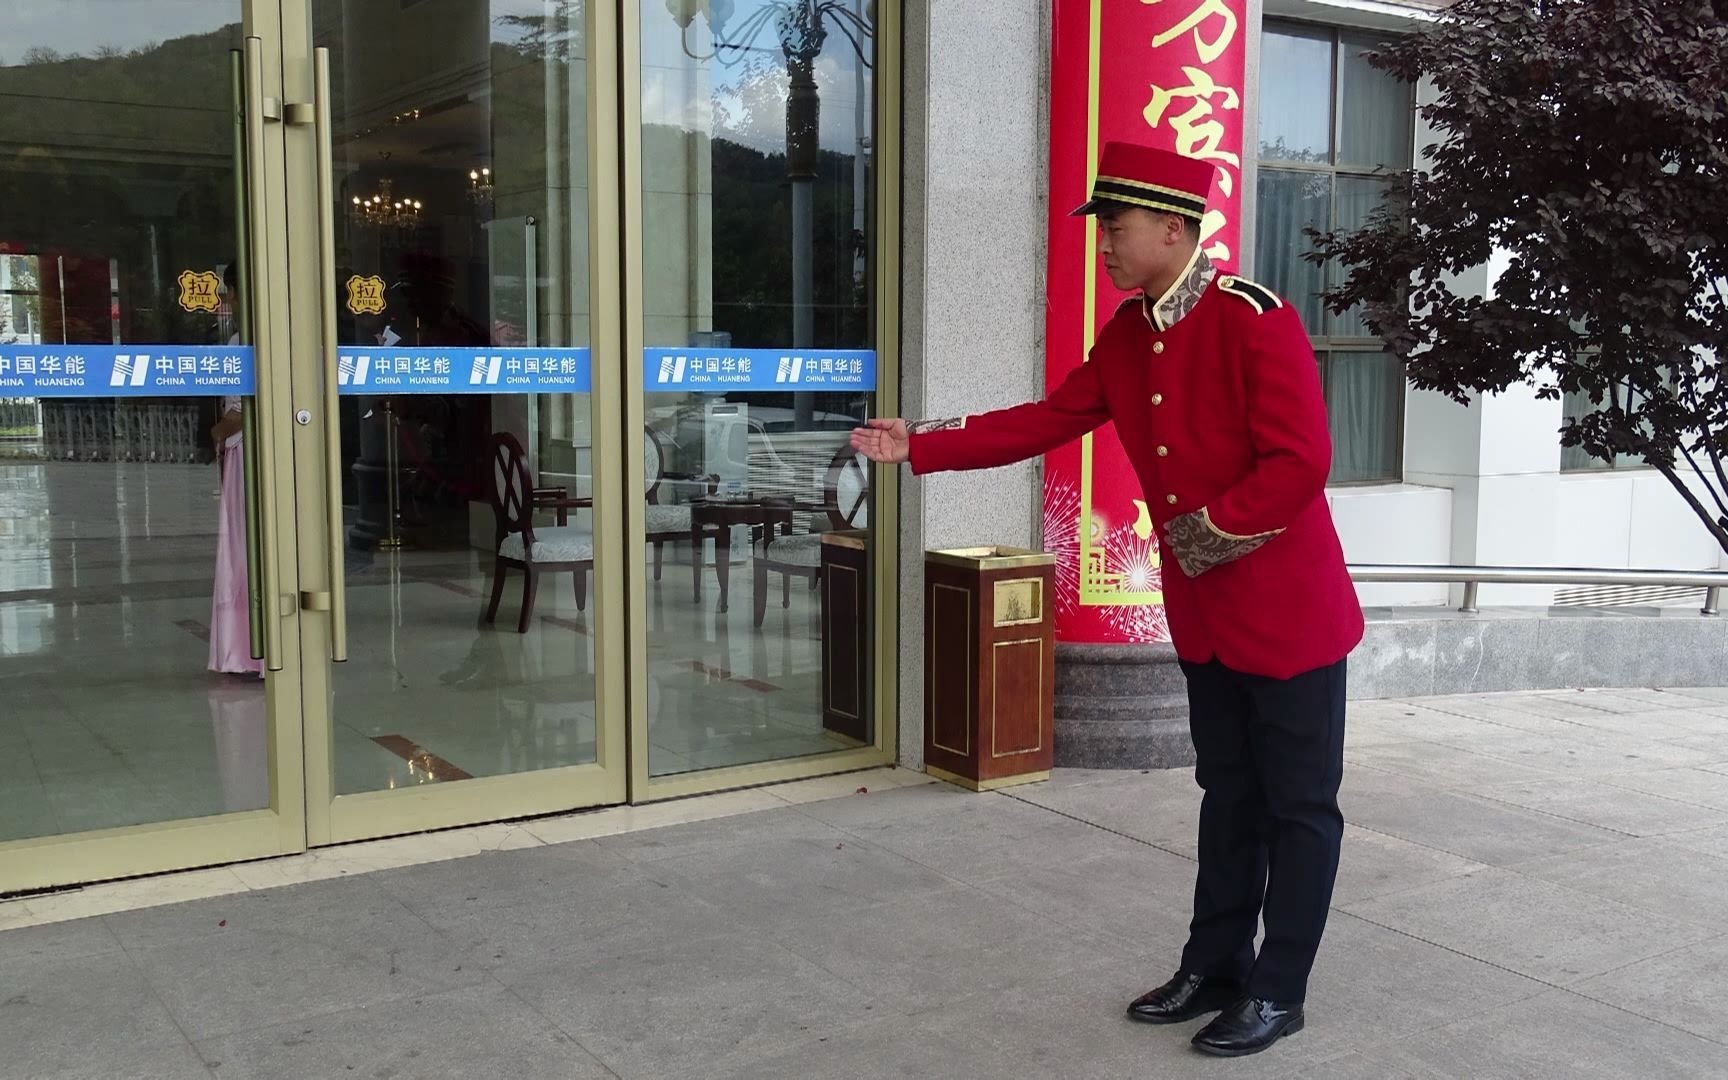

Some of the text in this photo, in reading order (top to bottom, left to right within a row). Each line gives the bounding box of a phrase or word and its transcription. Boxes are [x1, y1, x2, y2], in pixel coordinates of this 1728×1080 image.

[188, 279, 210, 296] 拉
[356, 283, 378, 299] 拉
[188, 296, 213, 304] PULL
[0, 355, 86, 375] 中国华能
[155, 355, 242, 374] 中国华能
[375, 356, 450, 374] 中国华能
[506, 357, 577, 374] 中国华能
[690, 357, 751, 373] 中国华能
[805, 358, 863, 374] 中国华能
[0, 377, 85, 386] HINA HUANENG
[155, 377, 241, 386] CHINA HUANENG
[375, 376, 449, 385] CHINA HUANENG
[506, 376, 575, 384] CHINA HUANENG
[690, 375, 751, 383] CHINA HUANENG
